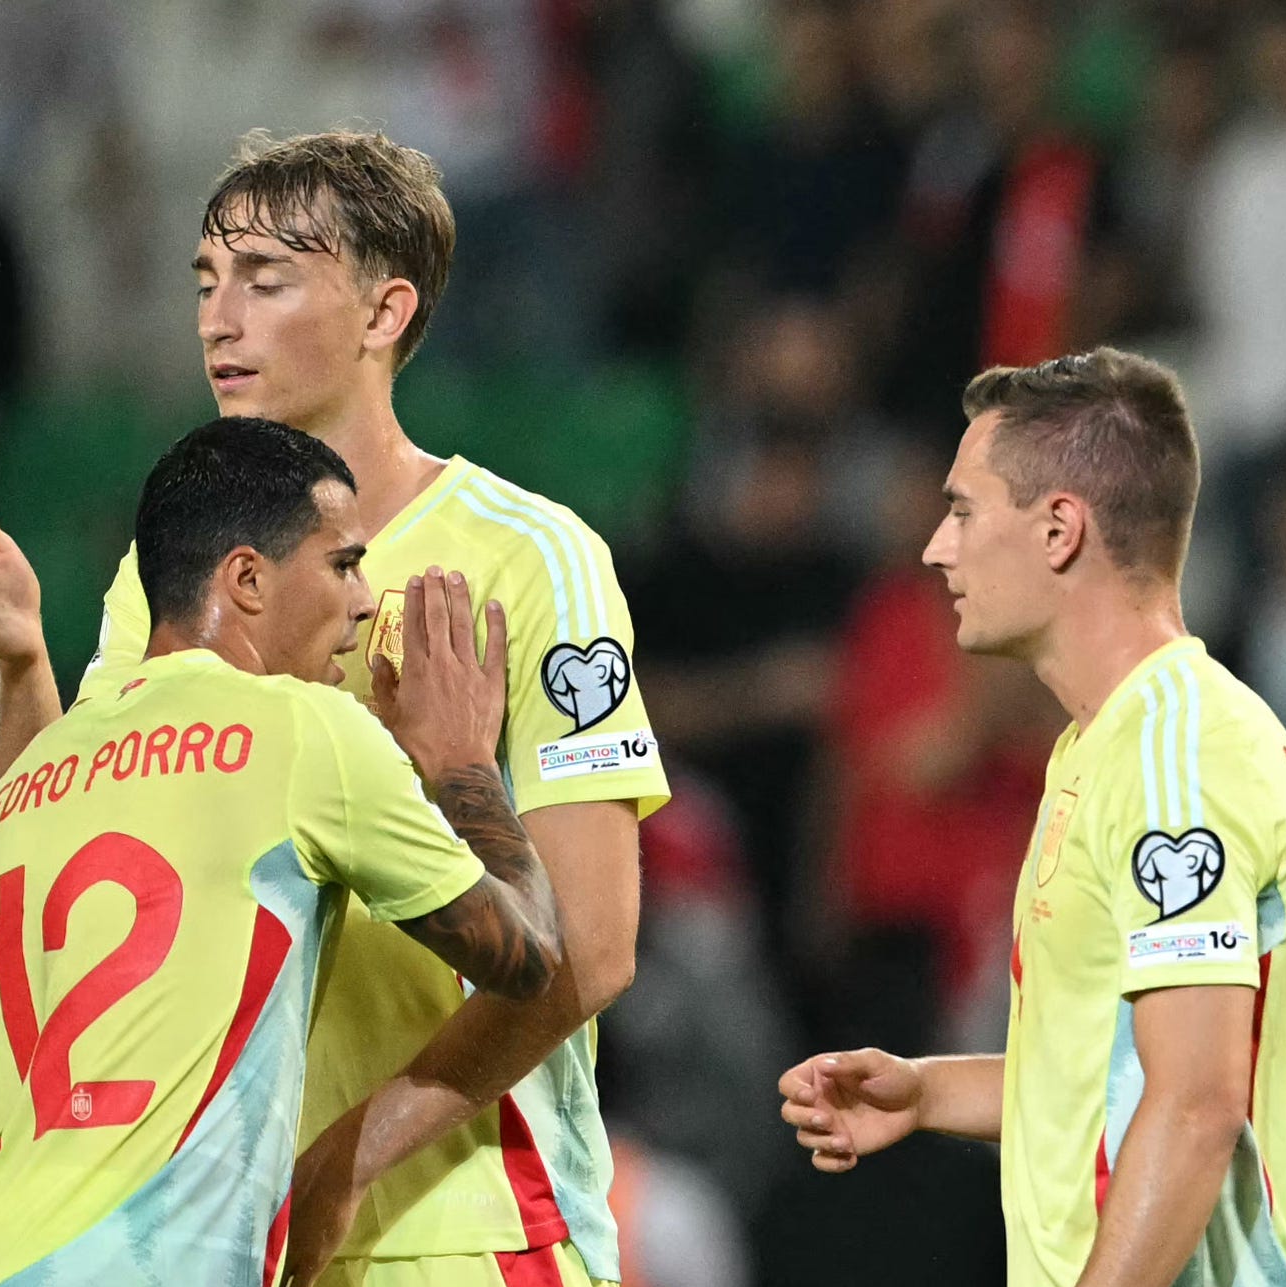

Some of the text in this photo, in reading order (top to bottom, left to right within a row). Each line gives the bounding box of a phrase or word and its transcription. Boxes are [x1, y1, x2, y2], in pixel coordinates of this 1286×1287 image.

[84, 721, 254, 793] PORRO
[541, 746, 619, 768] FOUNDATION
[620, 738, 649, 758] 10
[1130, 937, 1206, 954] FOUNDATION
[1209, 930, 1238, 951] 10
